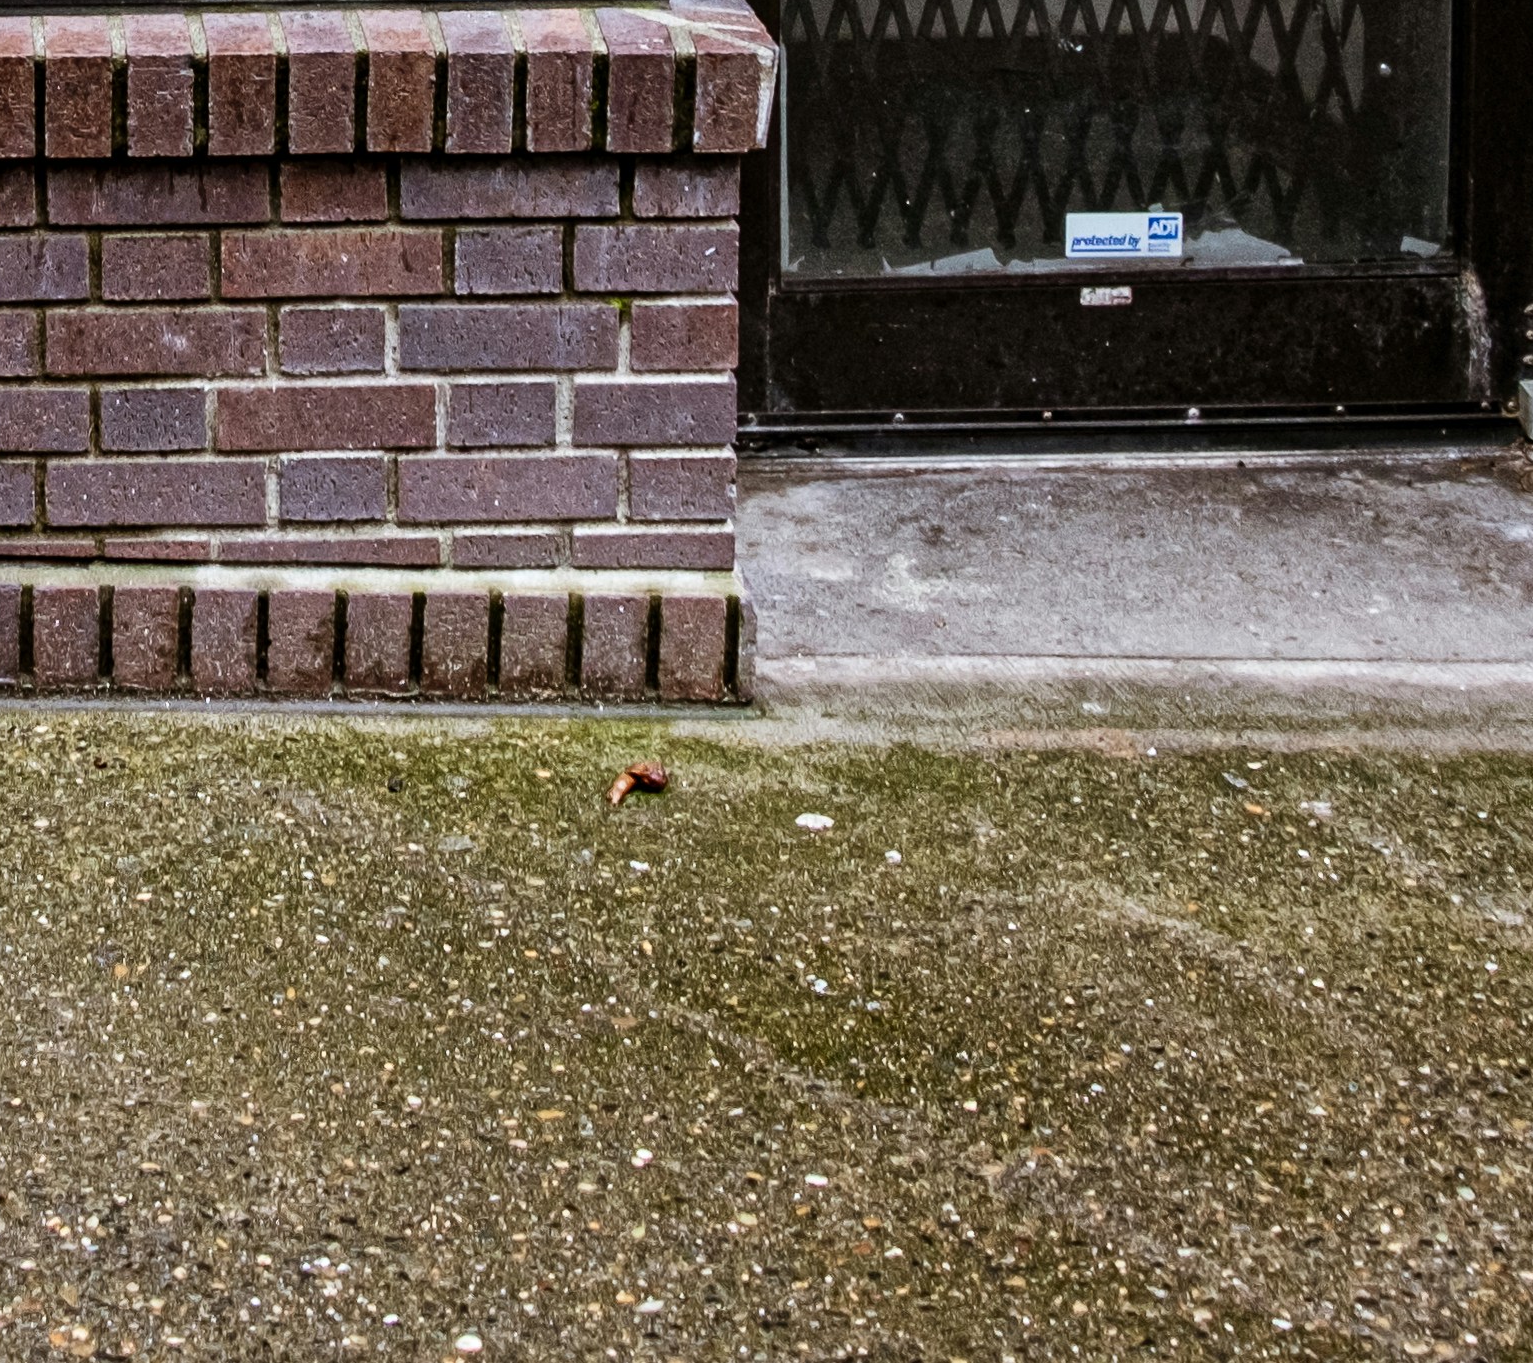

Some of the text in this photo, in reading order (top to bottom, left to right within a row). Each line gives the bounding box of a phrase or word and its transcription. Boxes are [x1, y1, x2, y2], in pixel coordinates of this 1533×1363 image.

[1148, 219, 1179, 237] ADT
[1071, 234, 1126, 248] protected
[1128, 234, 1141, 249] by
